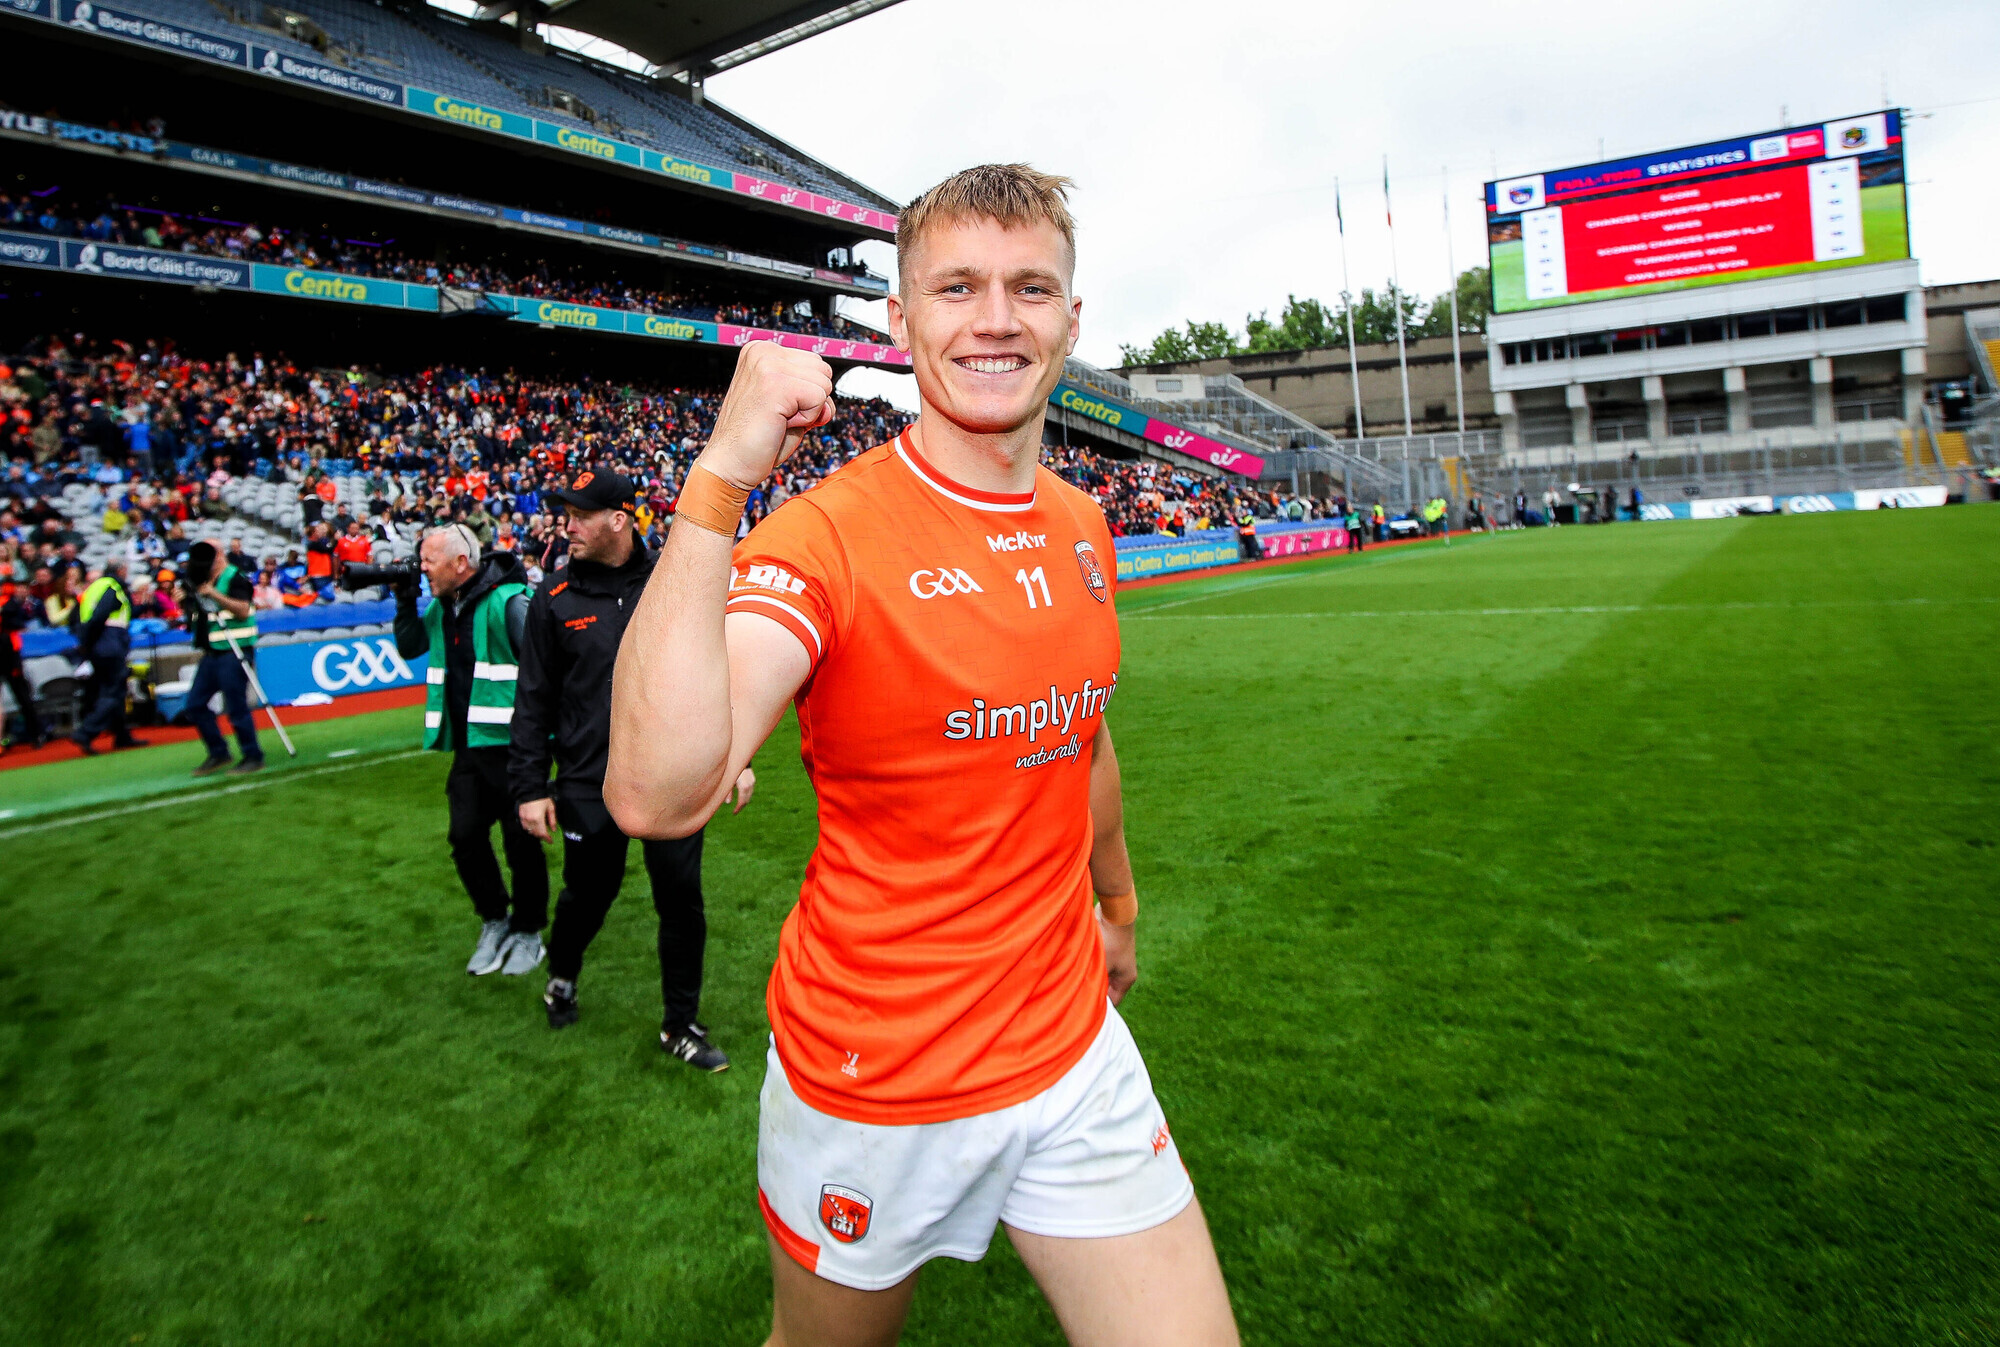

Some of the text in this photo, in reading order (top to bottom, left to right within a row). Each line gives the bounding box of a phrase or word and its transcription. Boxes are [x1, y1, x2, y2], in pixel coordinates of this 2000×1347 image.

[98, 10, 143, 36] Bord
[181, 31, 239, 62] Energy
[282, 57, 319, 81] Bord
[349, 76, 397, 102] Energy
[433, 96, 502, 130] Centra
[557, 128, 615, 158] Centra
[661, 155, 711, 183] Centra
[1647, 150, 1746, 177] STATISTICS
[102, 250, 148, 271] Bord
[185, 261, 241, 286] Energy
[284, 270, 368, 301] Centra
[538, 302, 598, 327] Centra
[644, 316, 696, 338] Centra
[1061, 389, 1122, 426] Centra
[1164, 429, 1242, 466] eir eir
[1117, 547, 1238, 575] ntra Centra Centra Centra Centra
[909, 567, 984, 600] GAA
[1015, 566, 1053, 609] 11
[311, 638, 414, 692] GAA
[1015, 734, 1083, 768] naturally
